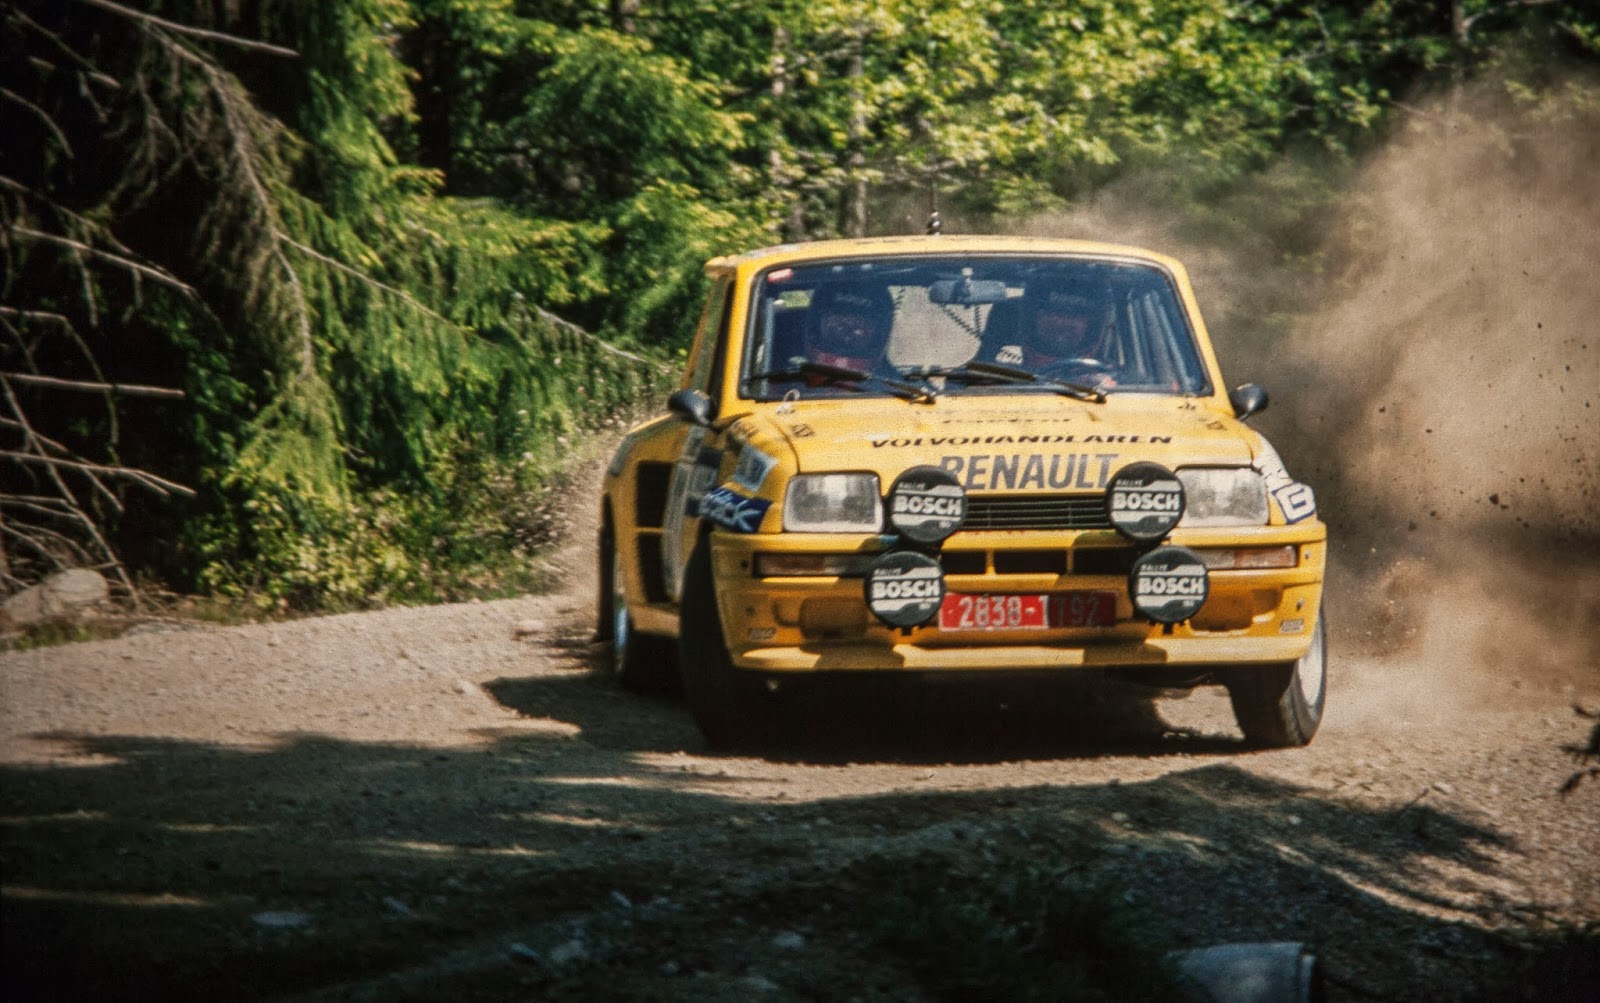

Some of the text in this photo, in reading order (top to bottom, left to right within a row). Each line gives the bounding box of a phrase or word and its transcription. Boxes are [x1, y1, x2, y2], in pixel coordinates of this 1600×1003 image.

[939, 453, 1119, 490] RENAULT
[894, 495, 962, 516] BOSCH
[1112, 492, 1180, 511] BOSCH
[872, 578, 940, 599] BOSCH
[1137, 576, 1205, 594] BOSCH
